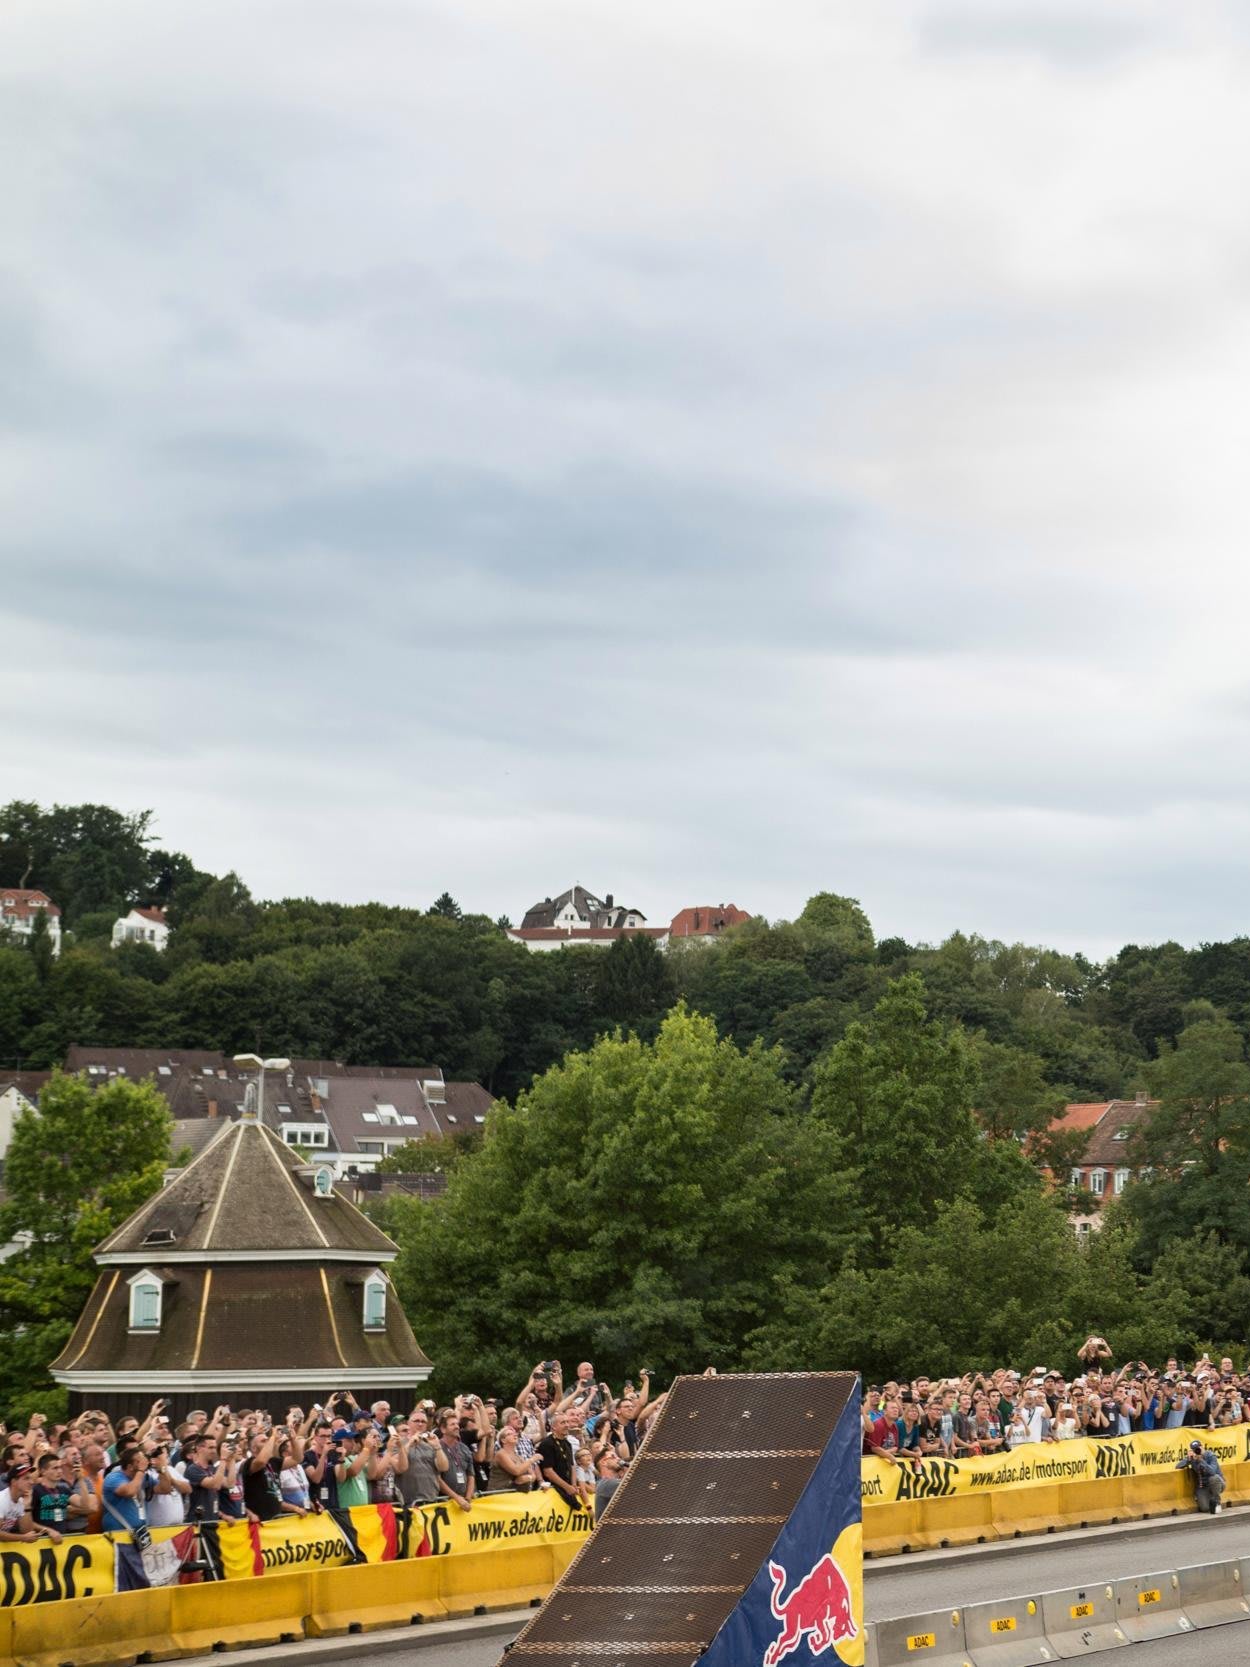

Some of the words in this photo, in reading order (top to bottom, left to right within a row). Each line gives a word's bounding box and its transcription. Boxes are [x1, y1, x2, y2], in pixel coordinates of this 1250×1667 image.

[896, 1461, 959, 1501] ADAC
[970, 1457, 1088, 1487] www.adac.de/motorspor
[1096, 1441, 1135, 1478] ADAC
[0, 1545, 93, 1607] DAC
[1144, 1592, 1156, 1603] ADAC
[1075, 1605, 1088, 1616] ADAC
[997, 1619, 1011, 1631] ADAC
[913, 1635, 929, 1648] ADAC
